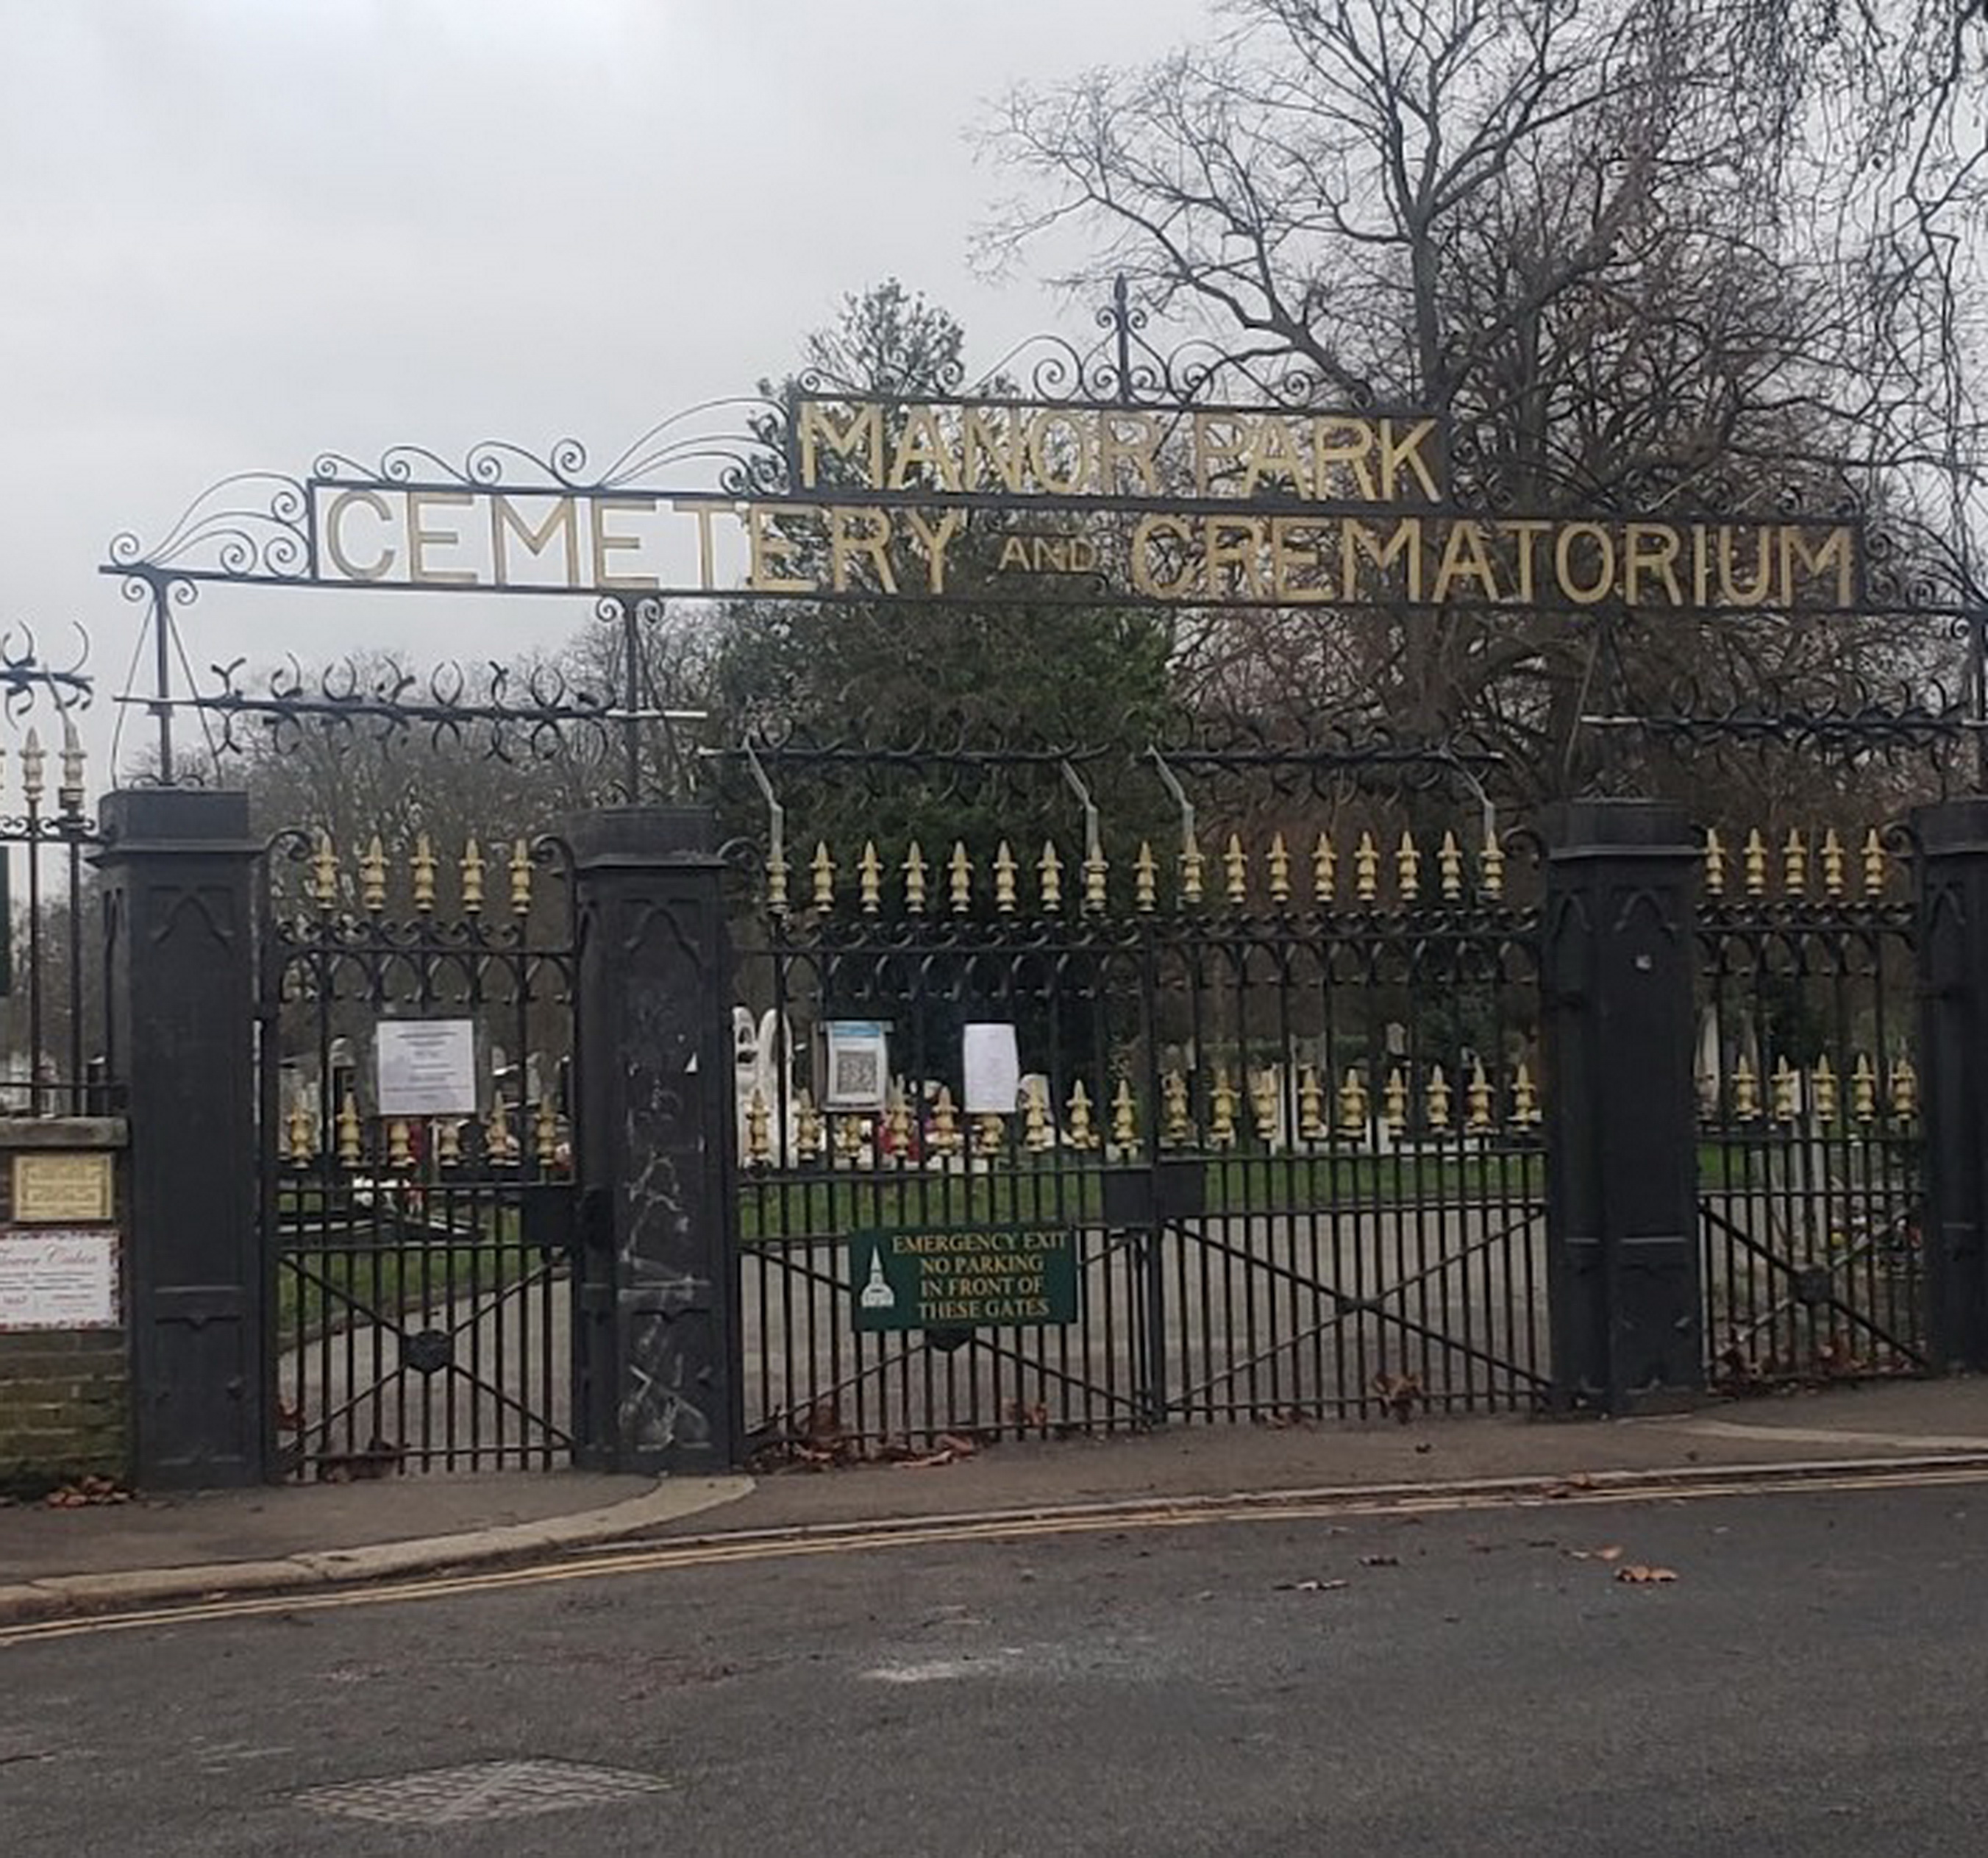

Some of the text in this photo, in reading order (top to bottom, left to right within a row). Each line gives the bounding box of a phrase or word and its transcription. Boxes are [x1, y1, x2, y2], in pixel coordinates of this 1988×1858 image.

[797, 399, 1442, 505] MANOR PARK
[327, 488, 1854, 609] CEMETERY AND CREMATORIUM
[892, 1231, 1069, 1254] EMERGENCY EXIT
[919, 1254, 1044, 1275] NO PARKING
[920, 1275, 1044, 1298] IN FRONT OF
[918, 1298, 1050, 1320] THESE GATES
